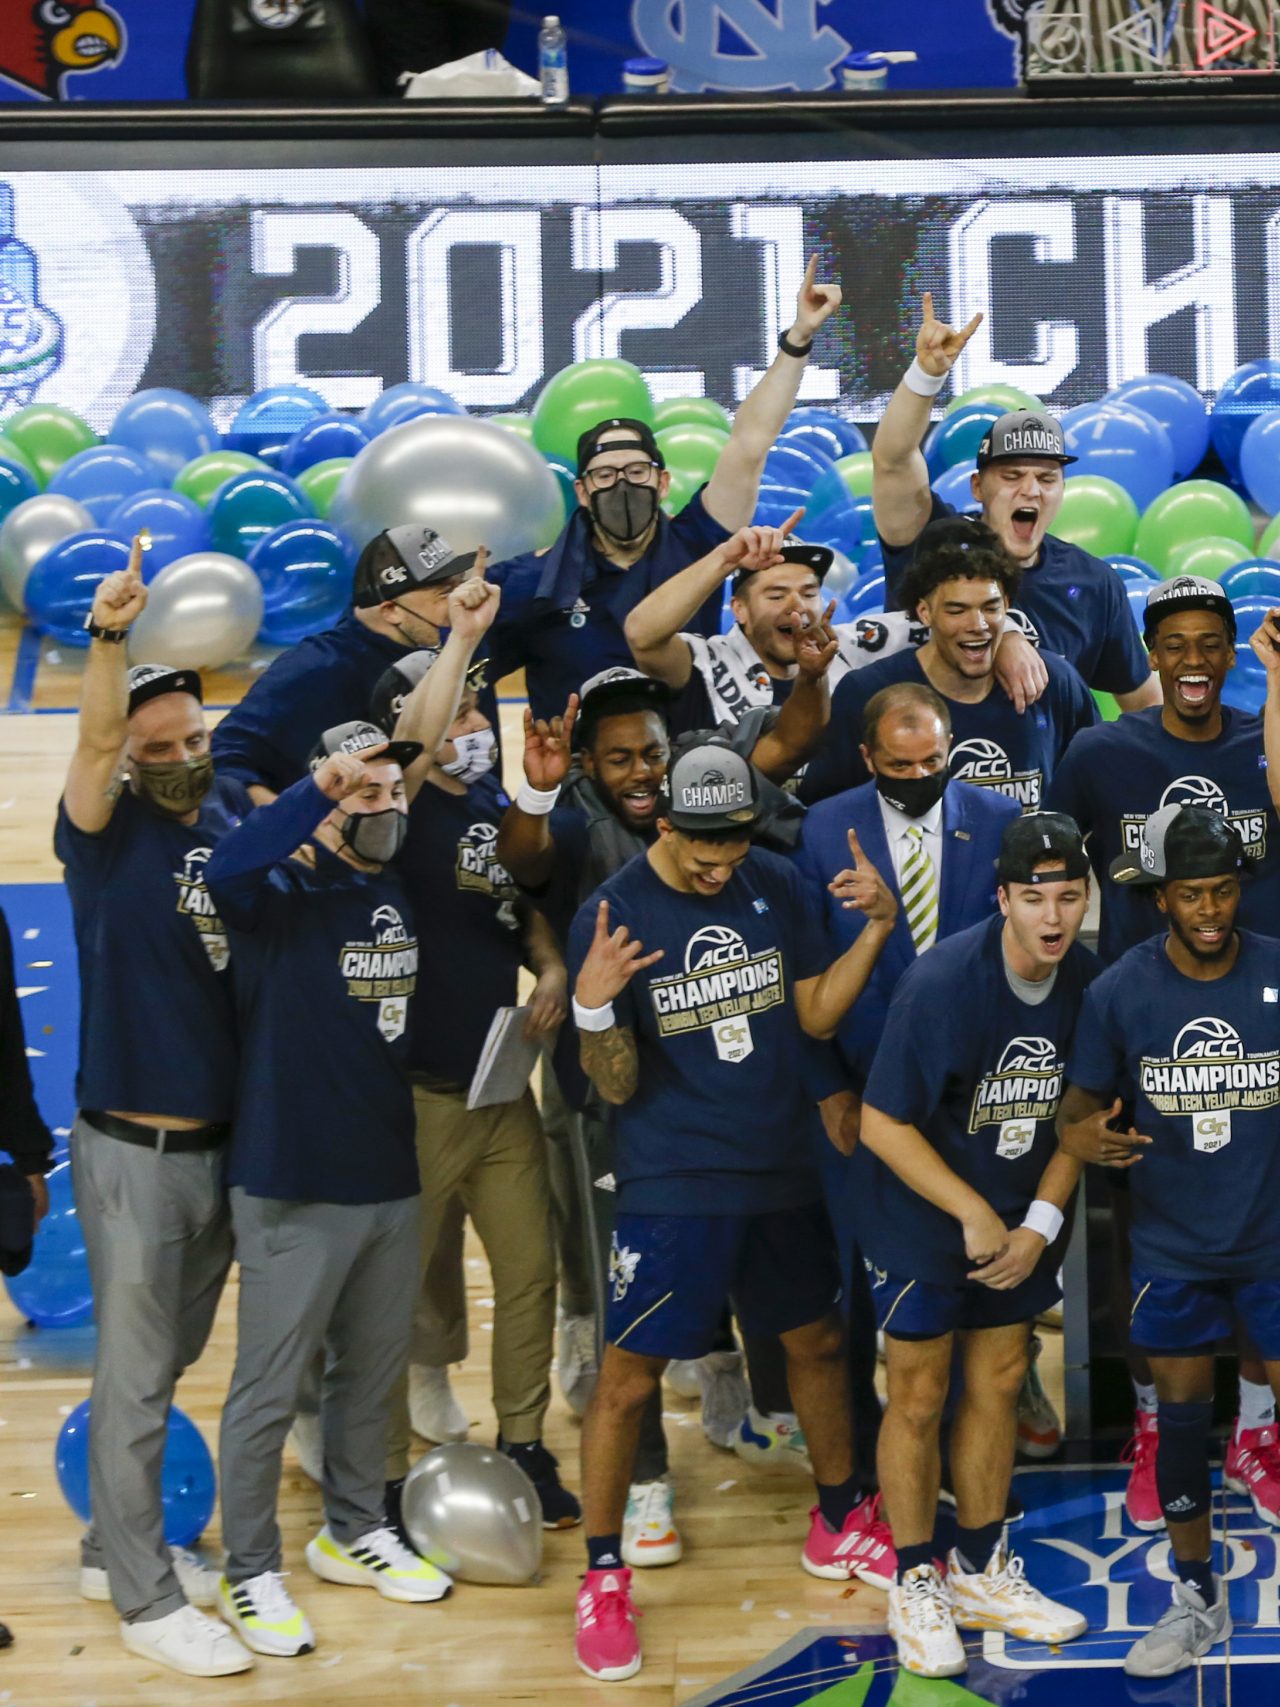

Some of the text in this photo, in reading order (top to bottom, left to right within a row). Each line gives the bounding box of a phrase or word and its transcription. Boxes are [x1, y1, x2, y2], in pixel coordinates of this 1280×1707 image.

[251, 205, 840, 406] 2021
[1003, 430, 1060, 453] CHAMPS
[418, 537, 455, 569] CHA
[953, 758, 1009, 780] ACC
[682, 782, 745, 808] CHAMPS
[693, 941, 745, 971] ACC
[652, 957, 780, 1014] CHAMPIONS
[717, 1024, 747, 1044] GT
[1180, 1039, 1241, 1059] ACC
[1002, 1053, 1057, 1072] ACC
[1142, 1060, 1280, 1093] CHAMPIONS
[1202, 1091, 1240, 1110] YELLOW
[1002, 1125, 1033, 1144] GT
[1196, 1117, 1228, 1136] GT
[1203, 1140, 1222, 1150] 2021
